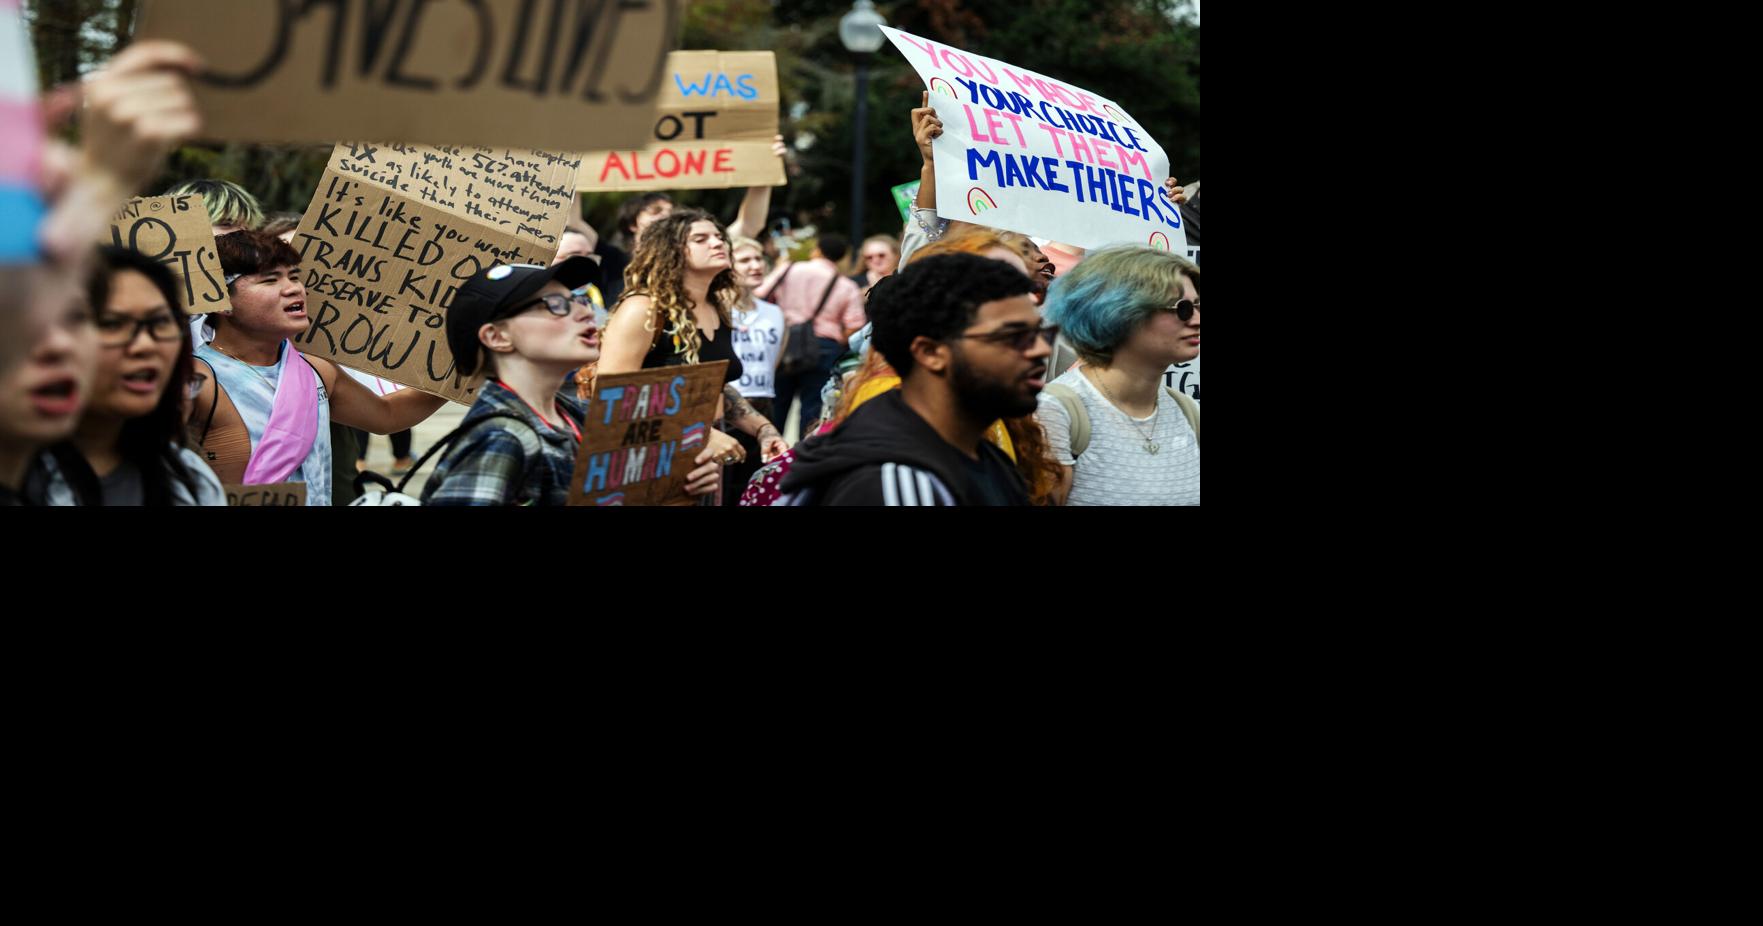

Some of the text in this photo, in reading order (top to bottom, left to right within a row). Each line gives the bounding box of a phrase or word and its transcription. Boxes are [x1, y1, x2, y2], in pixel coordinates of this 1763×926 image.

[674, 73, 758, 100] WAS
[899, 34, 1110, 118] YOU MADE
[654, 111, 717, 141] OT
[955, 76, 1149, 153] YOUR CHOICE
[962, 104, 1153, 181] LET THEM
[386, 161, 402, 173] as
[410, 162, 457, 197] likely
[465, 183, 481, 199] to
[488, 196, 549, 222] attempt
[505, 150, 541, 172] have
[599, 148, 736, 182] ALONE
[966, 148, 1181, 229] MAKE THIERS
[326, 176, 523, 261] It's like you want
[340, 159, 556, 243] suicide than their peers
[484, 176, 514, 192] more
[521, 186, 561, 209] than
[299, 233, 388, 283] TRANS
[314, 203, 444, 266] KILLED
[304, 268, 444, 329] DESERVE TO
[295, 300, 421, 370] ROW
[599, 375, 686, 425] TRANS
[622, 420, 663, 446] ARE
[583, 440, 677, 494] HUMAN
